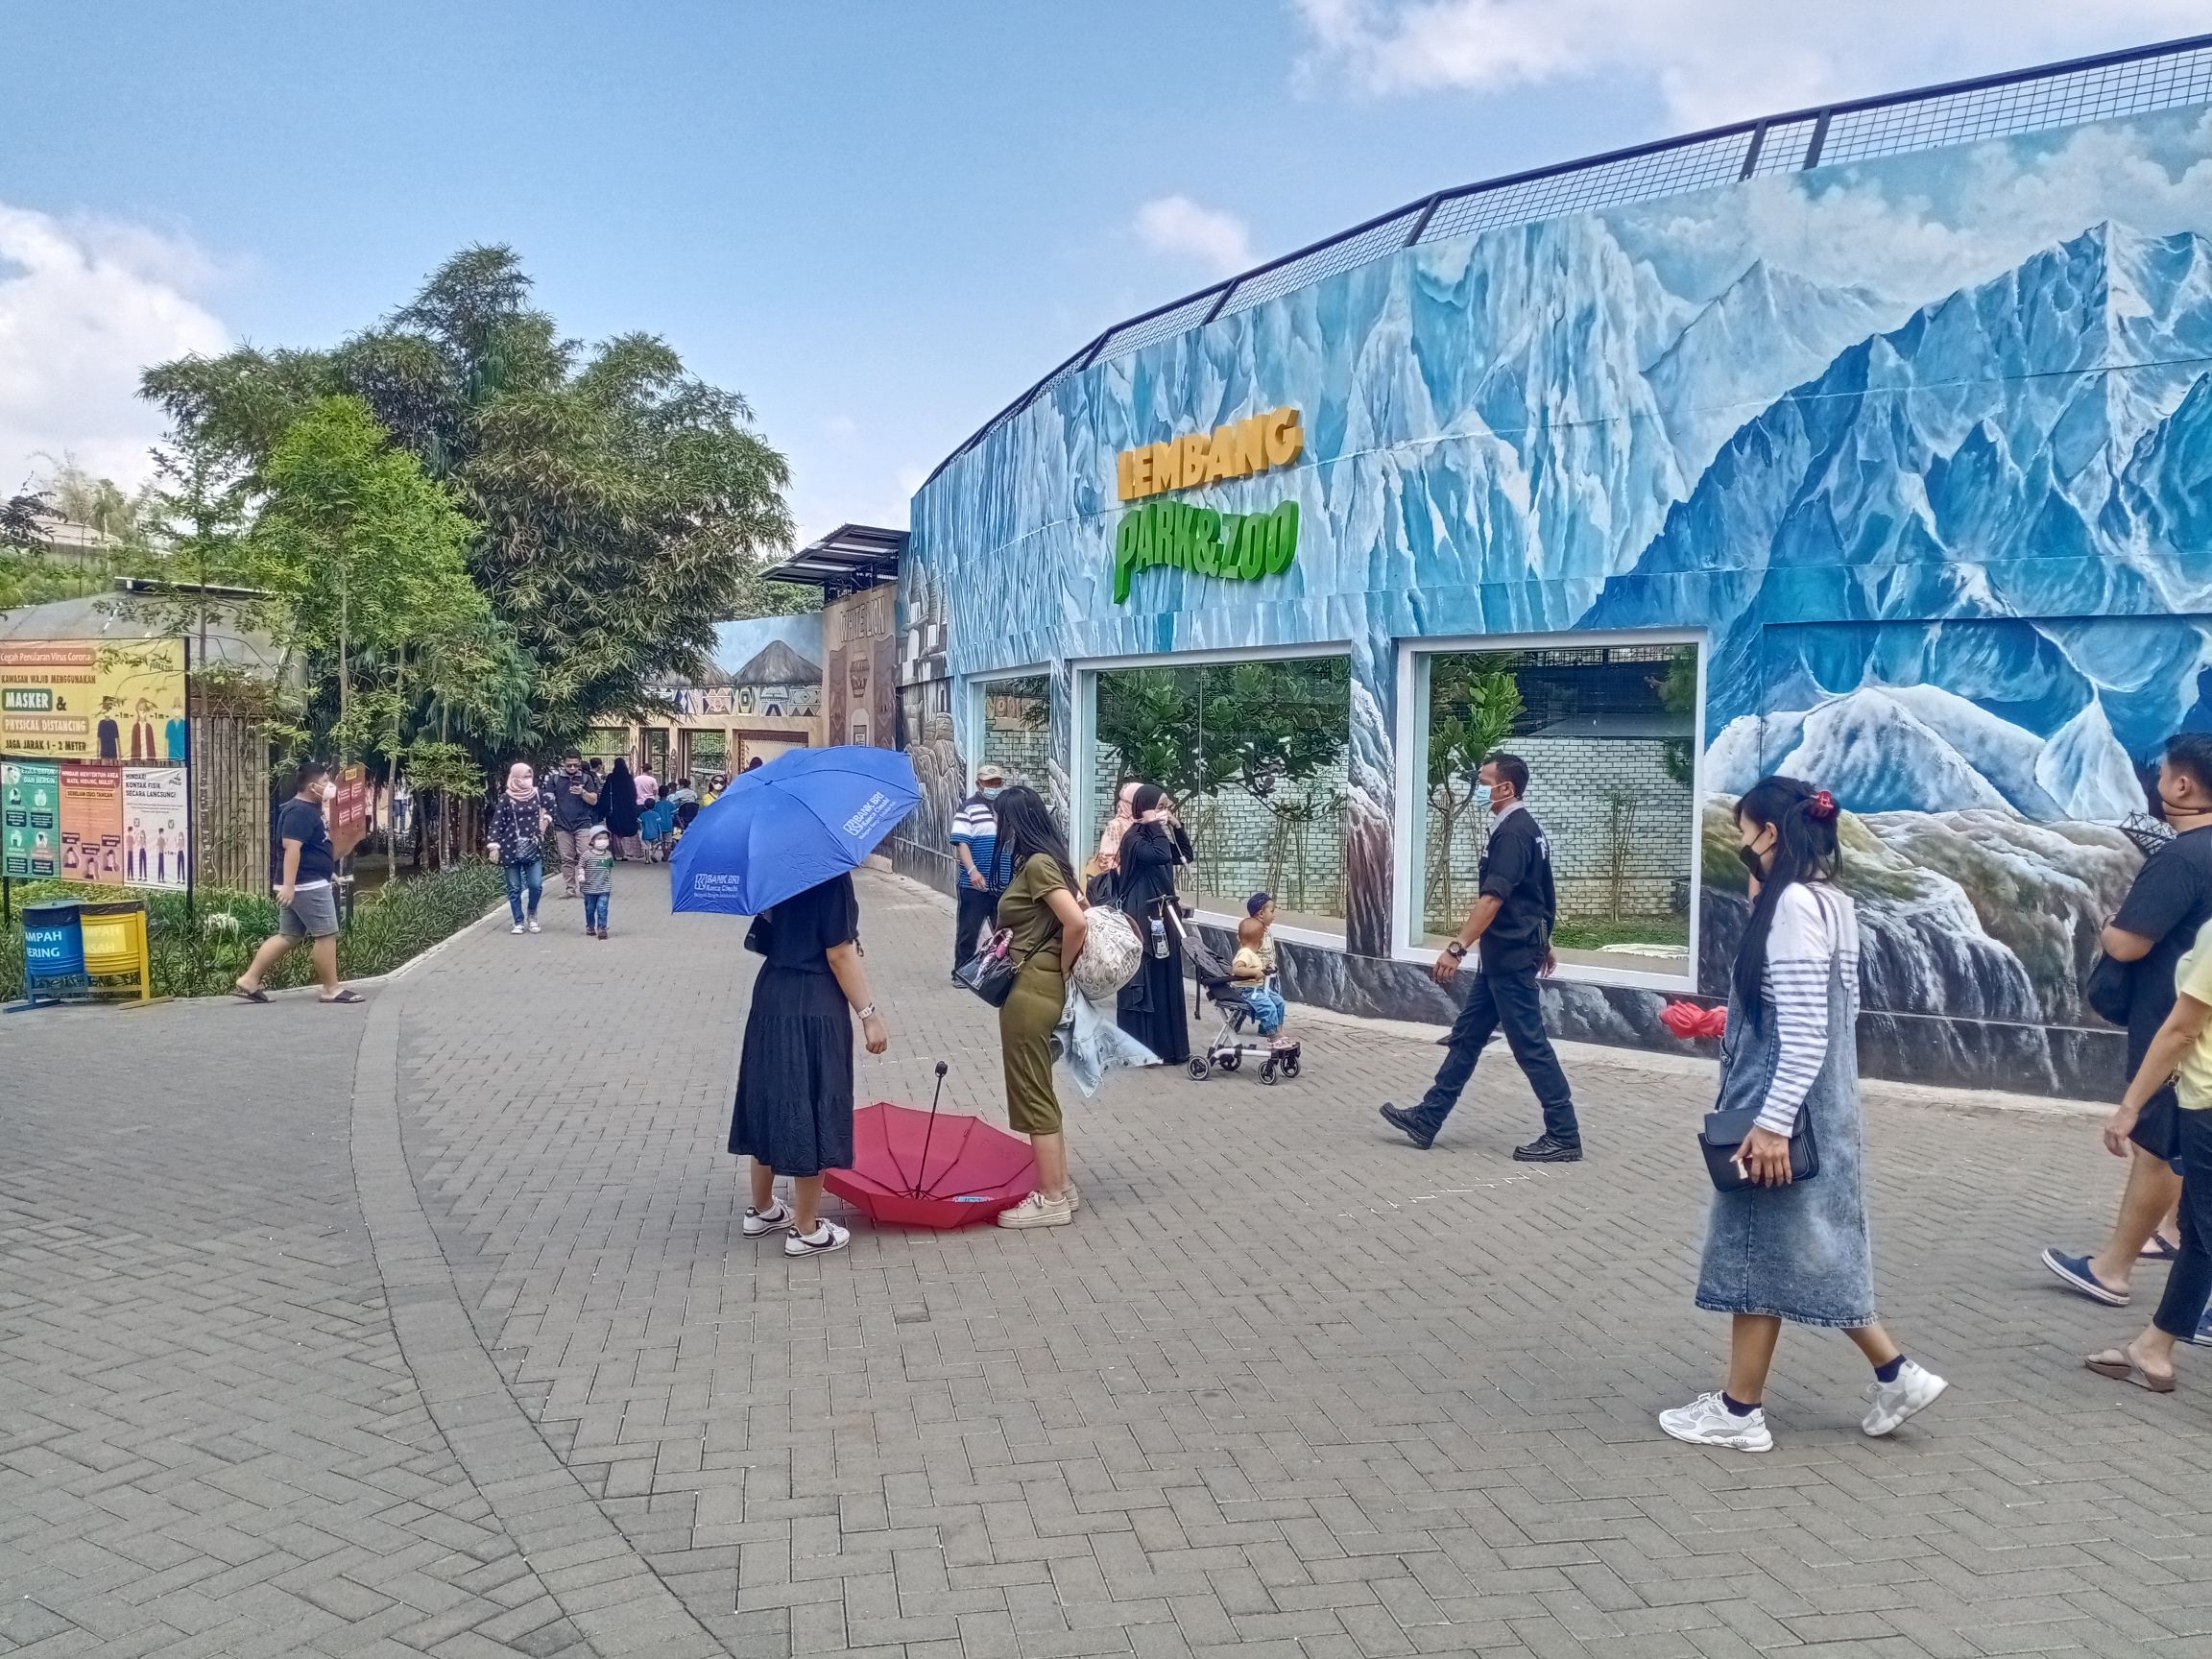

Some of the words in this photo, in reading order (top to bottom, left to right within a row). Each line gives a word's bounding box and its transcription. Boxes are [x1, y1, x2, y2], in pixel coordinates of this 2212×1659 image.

[1118, 406, 1304, 500] LEMBANG
[1114, 500, 1299, 604] PARK&ZOO
[840, 603, 865, 642] WHITE
[866, 595, 884, 637] LION
[0, 653, 19, 663] Cegah
[19, 653, 50, 661] Penularan
[51, 653, 67, 661] Virus
[67, 653, 91, 661] Corona
[1, 675, 29, 684] KAWASAN
[30, 675, 49, 684] WAJIB
[50, 675, 96, 684] MENGGUNAKAN
[5, 691, 49, 709] MASKER
[56, 696, 67, 711] &
[5, 719, 39, 731] PHYSICAL
[41, 719, 86, 732] DISTANCING
[5, 739, 21, 749] JAGA
[23, 739, 44, 750] JARAK
[58, 741, 63, 750] 2
[64, 741, 86, 752] METER
[853, 802, 875, 823] BANK
[869, 791, 885, 805] BRI
[707, 874, 728, 884] BANK
[728, 875, 740, 884] BRI
[27, 947, 60, 958] ERING
